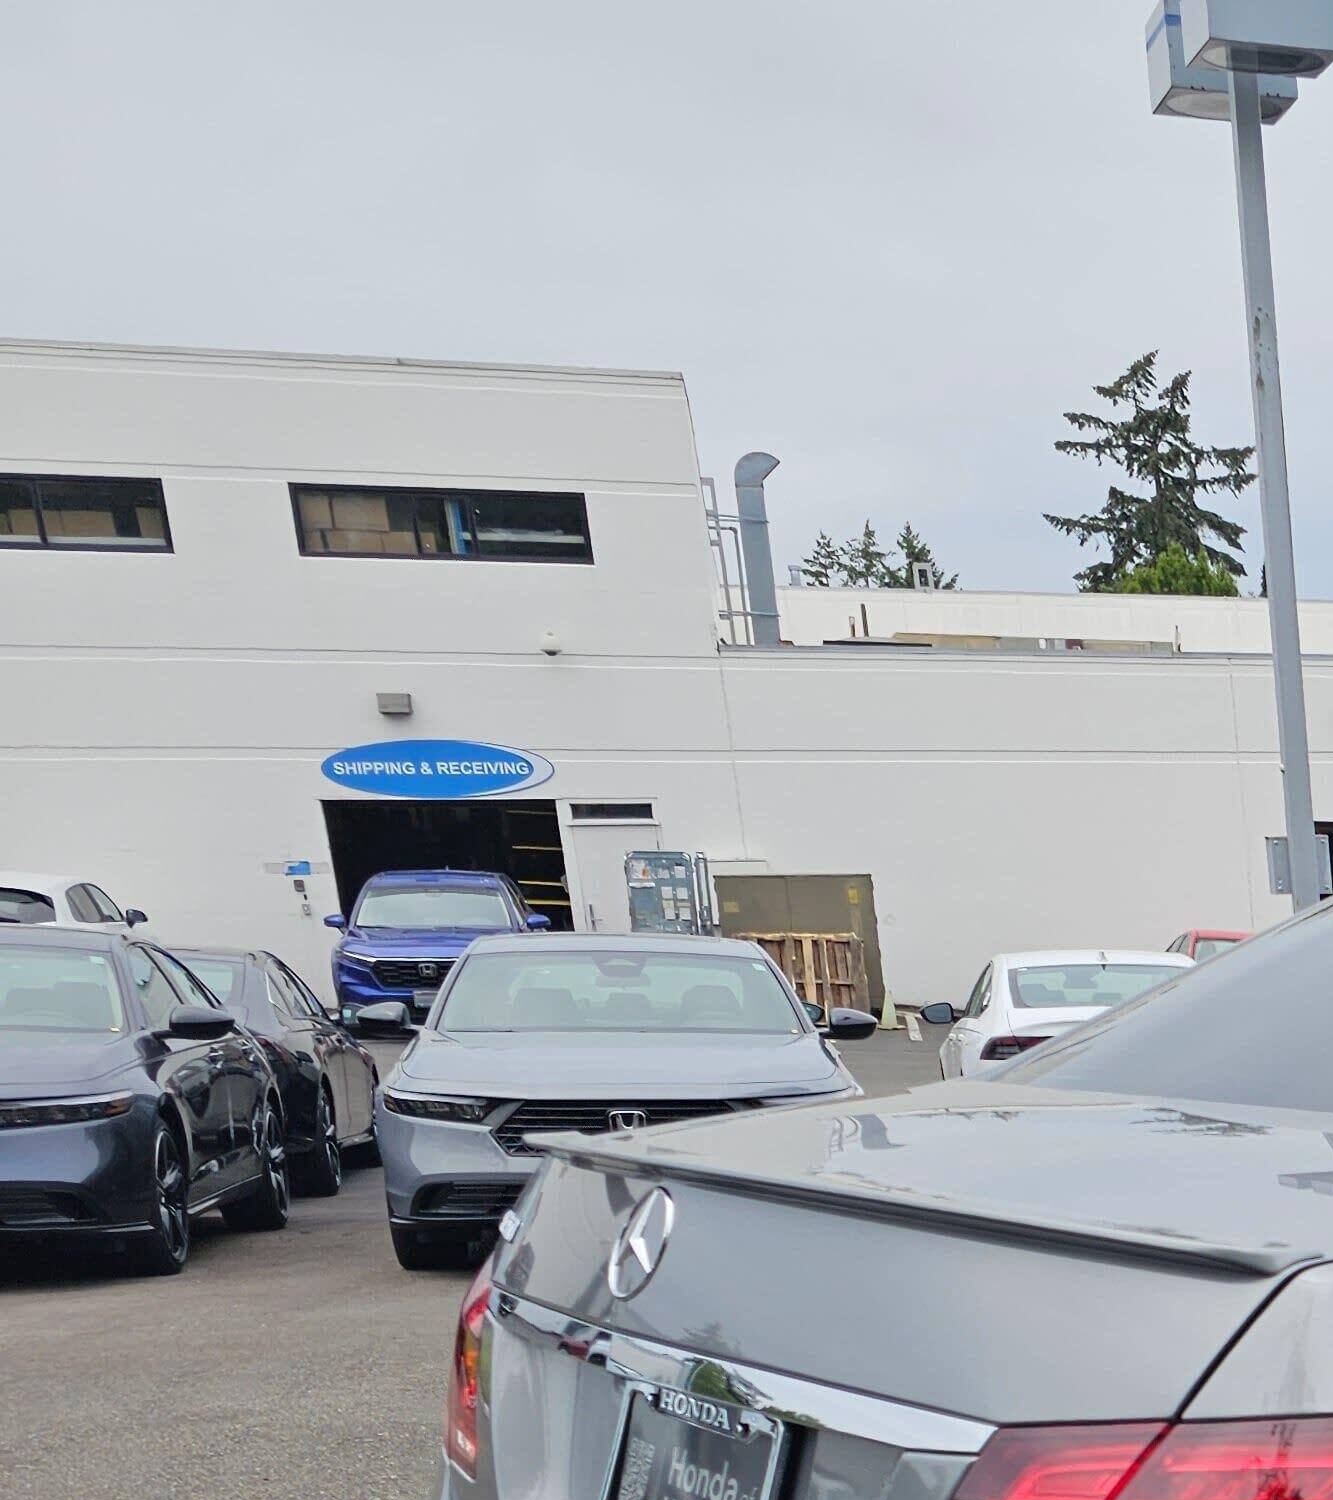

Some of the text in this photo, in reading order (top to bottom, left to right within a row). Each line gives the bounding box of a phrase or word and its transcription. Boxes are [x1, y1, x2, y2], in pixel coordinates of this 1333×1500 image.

[333, 761, 530, 775] SHIPPING & RECEIVING
[659, 1388, 731, 1431] HONDA
